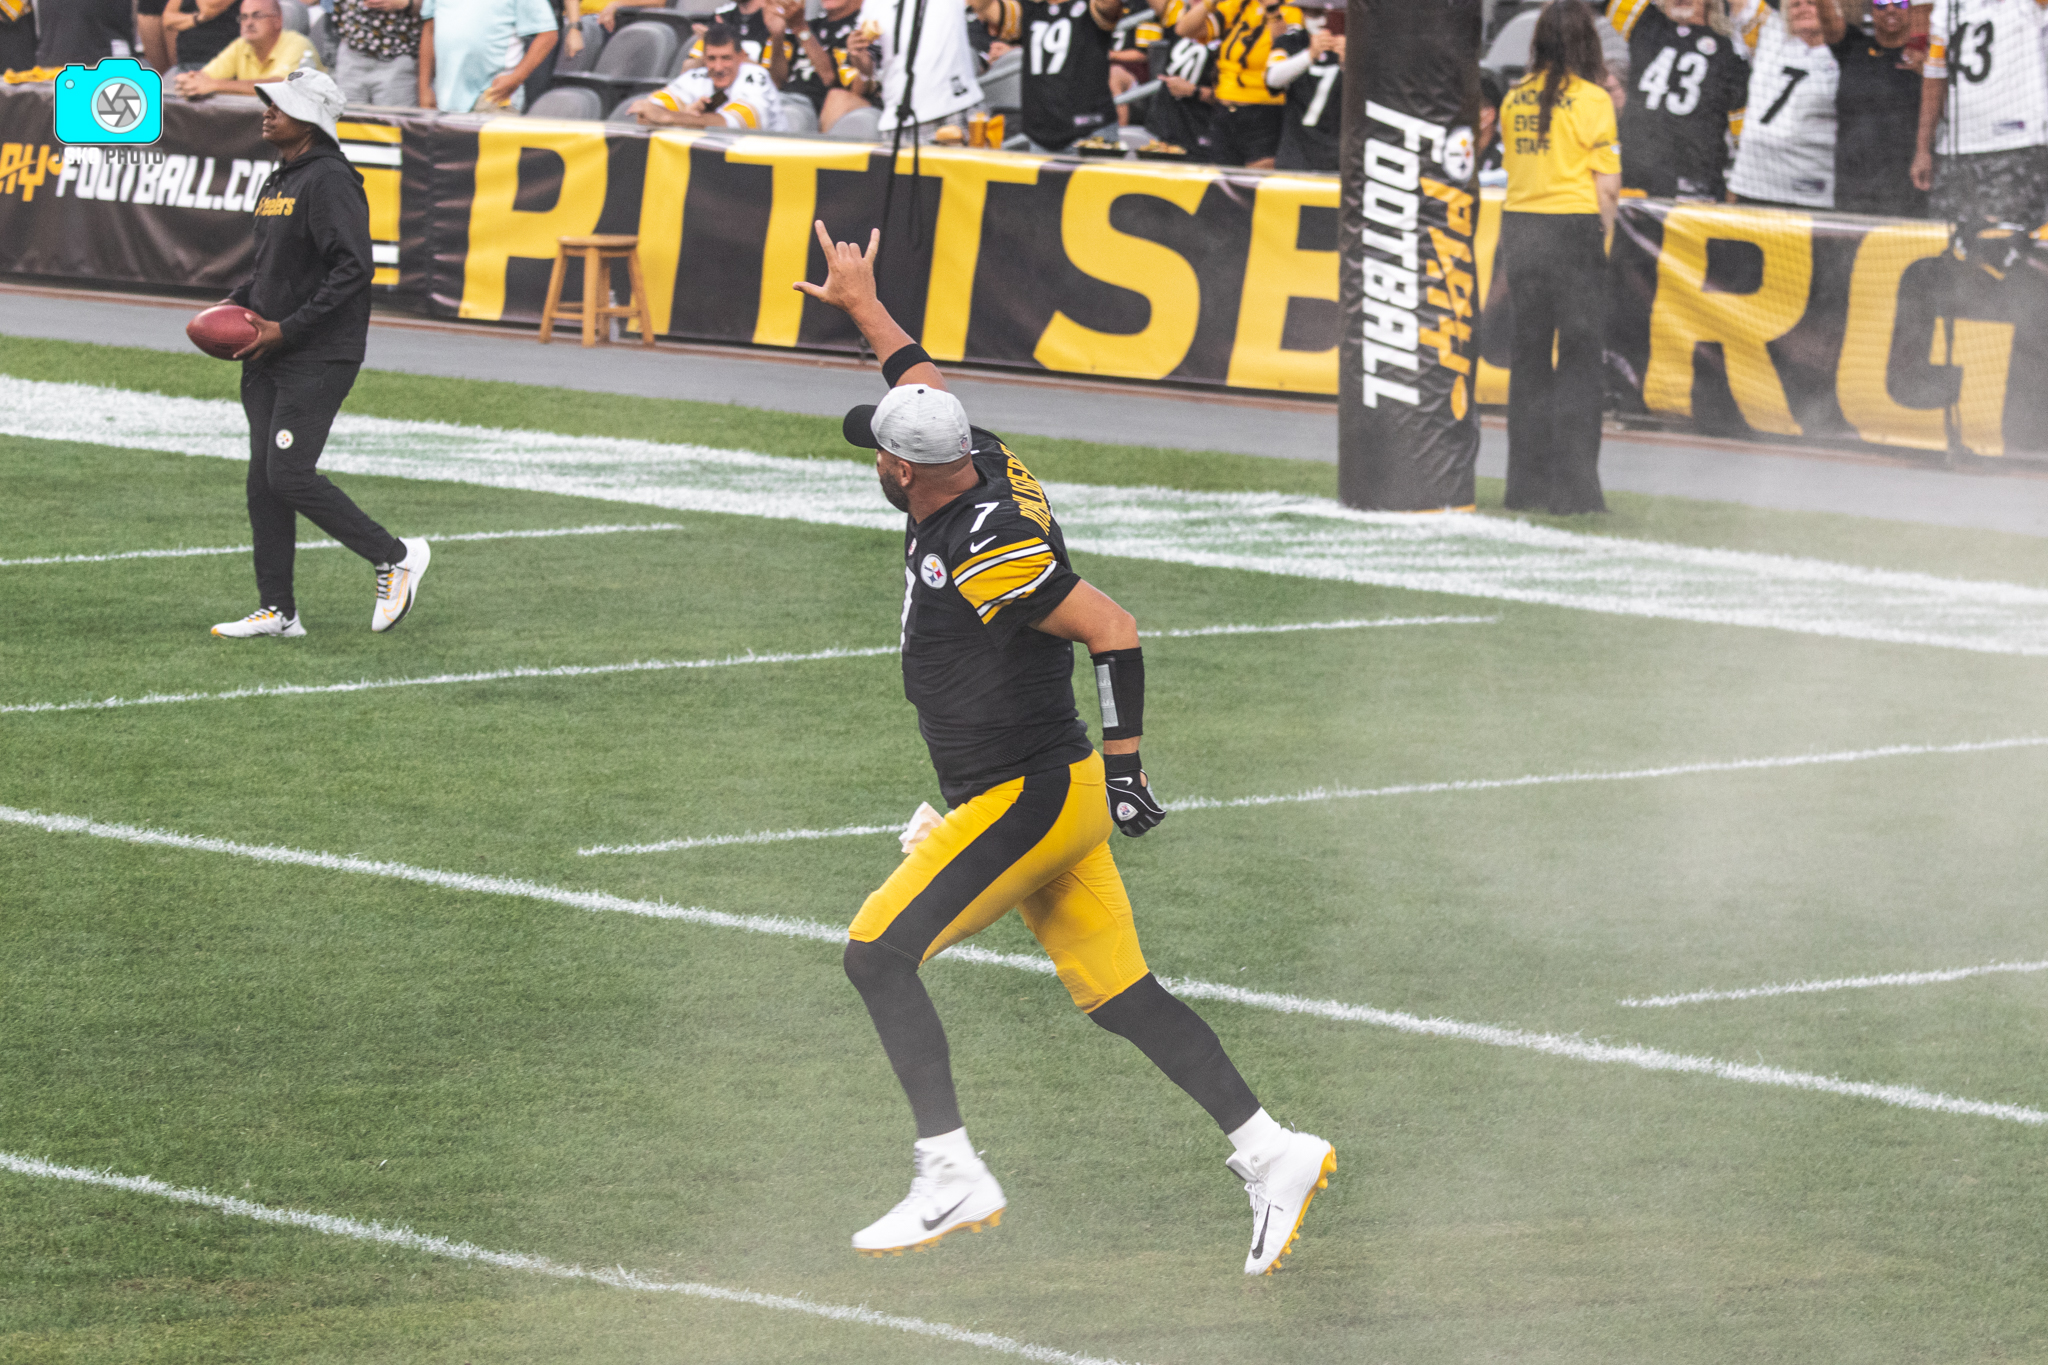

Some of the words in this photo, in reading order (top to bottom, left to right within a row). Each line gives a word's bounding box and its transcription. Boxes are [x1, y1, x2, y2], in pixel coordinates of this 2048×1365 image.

[1030, 17, 1072, 75] 19
[1302, 63, 1340, 127] 7
[1638, 46, 1709, 116] 43
[1760, 65, 1810, 125] 7
[1515, 137, 1550, 156] STAFF
[55, 148, 280, 212] FOOTBALL.CO
[254, 191, 296, 216] Steelers
[1362, 100, 1446, 409] FOOTBALL
[458, 117, 2016, 457] PITTSBRG
[969, 502, 999, 533] 7
